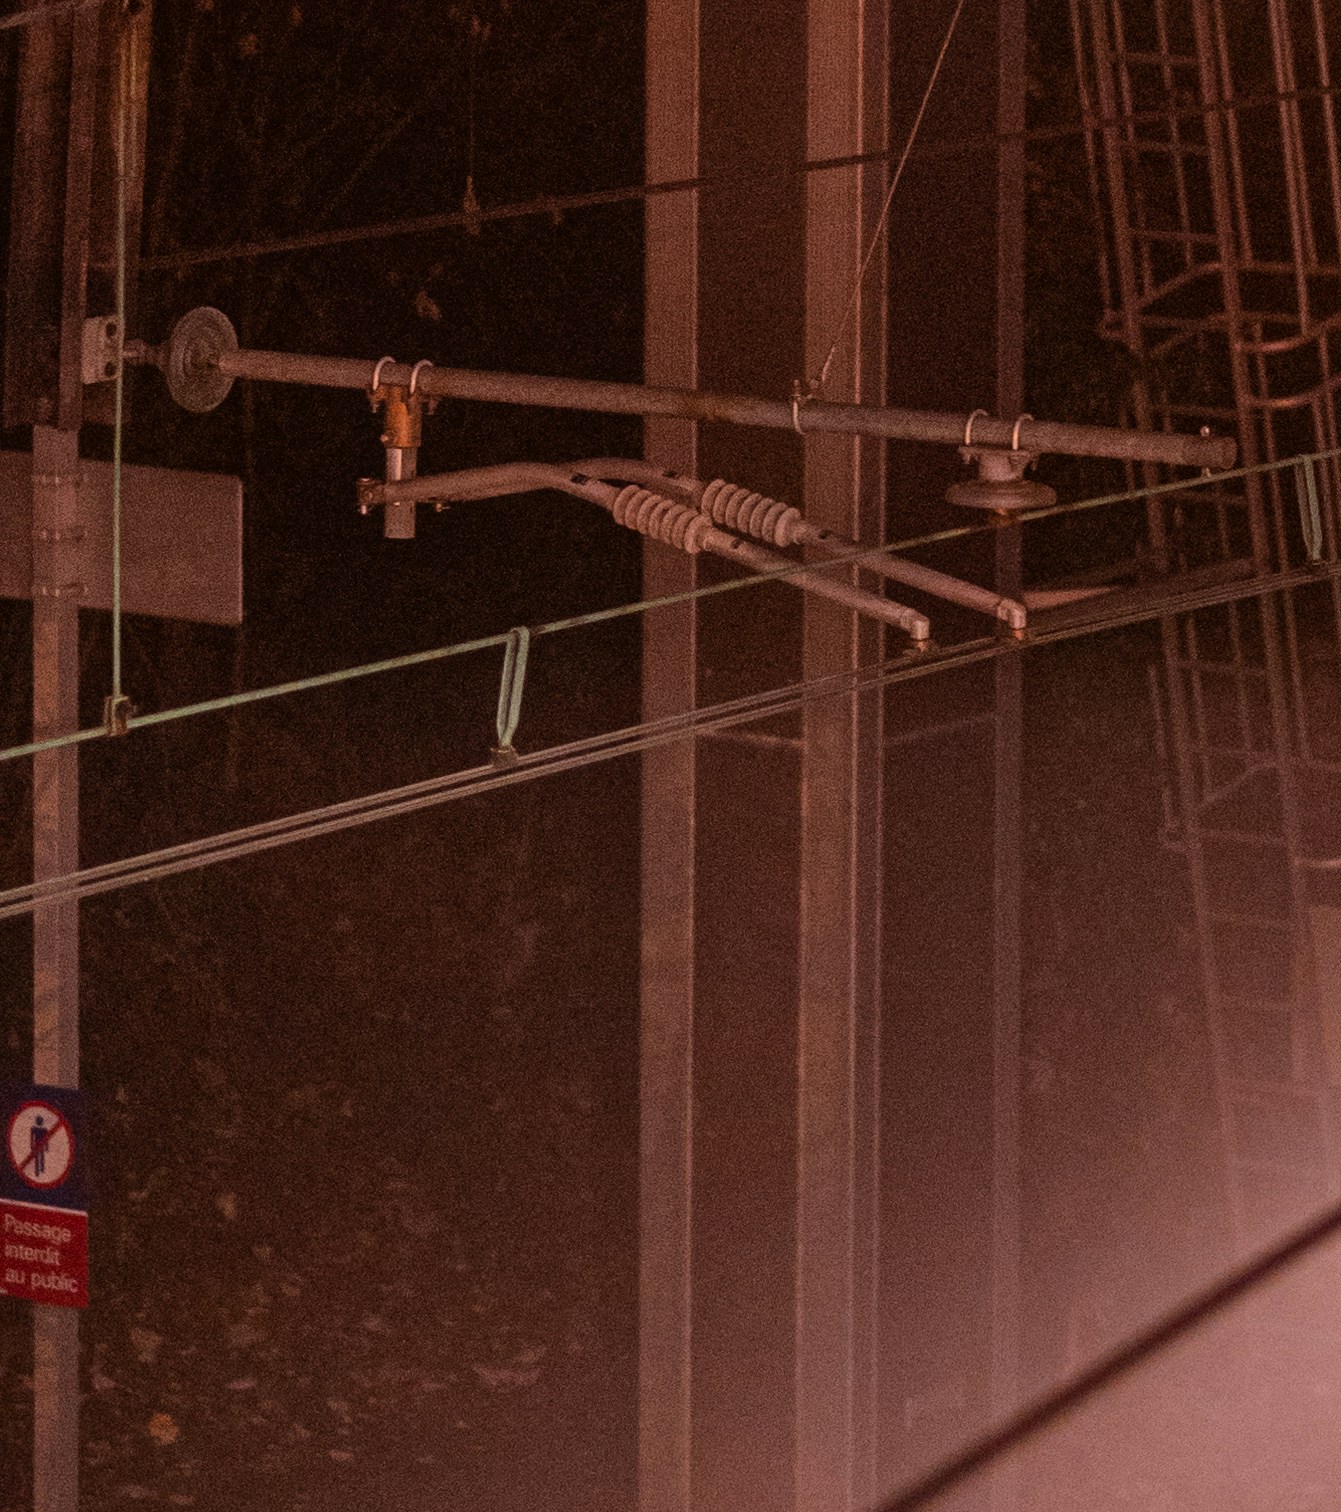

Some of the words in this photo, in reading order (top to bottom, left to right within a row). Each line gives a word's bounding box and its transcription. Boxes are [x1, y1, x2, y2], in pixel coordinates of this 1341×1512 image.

[3, 1211, 72, 1245] Passage
[4, 1240, 61, 1267] interdit
[4, 1267, 26, 1285] au
[30, 1270, 79, 1294] public
